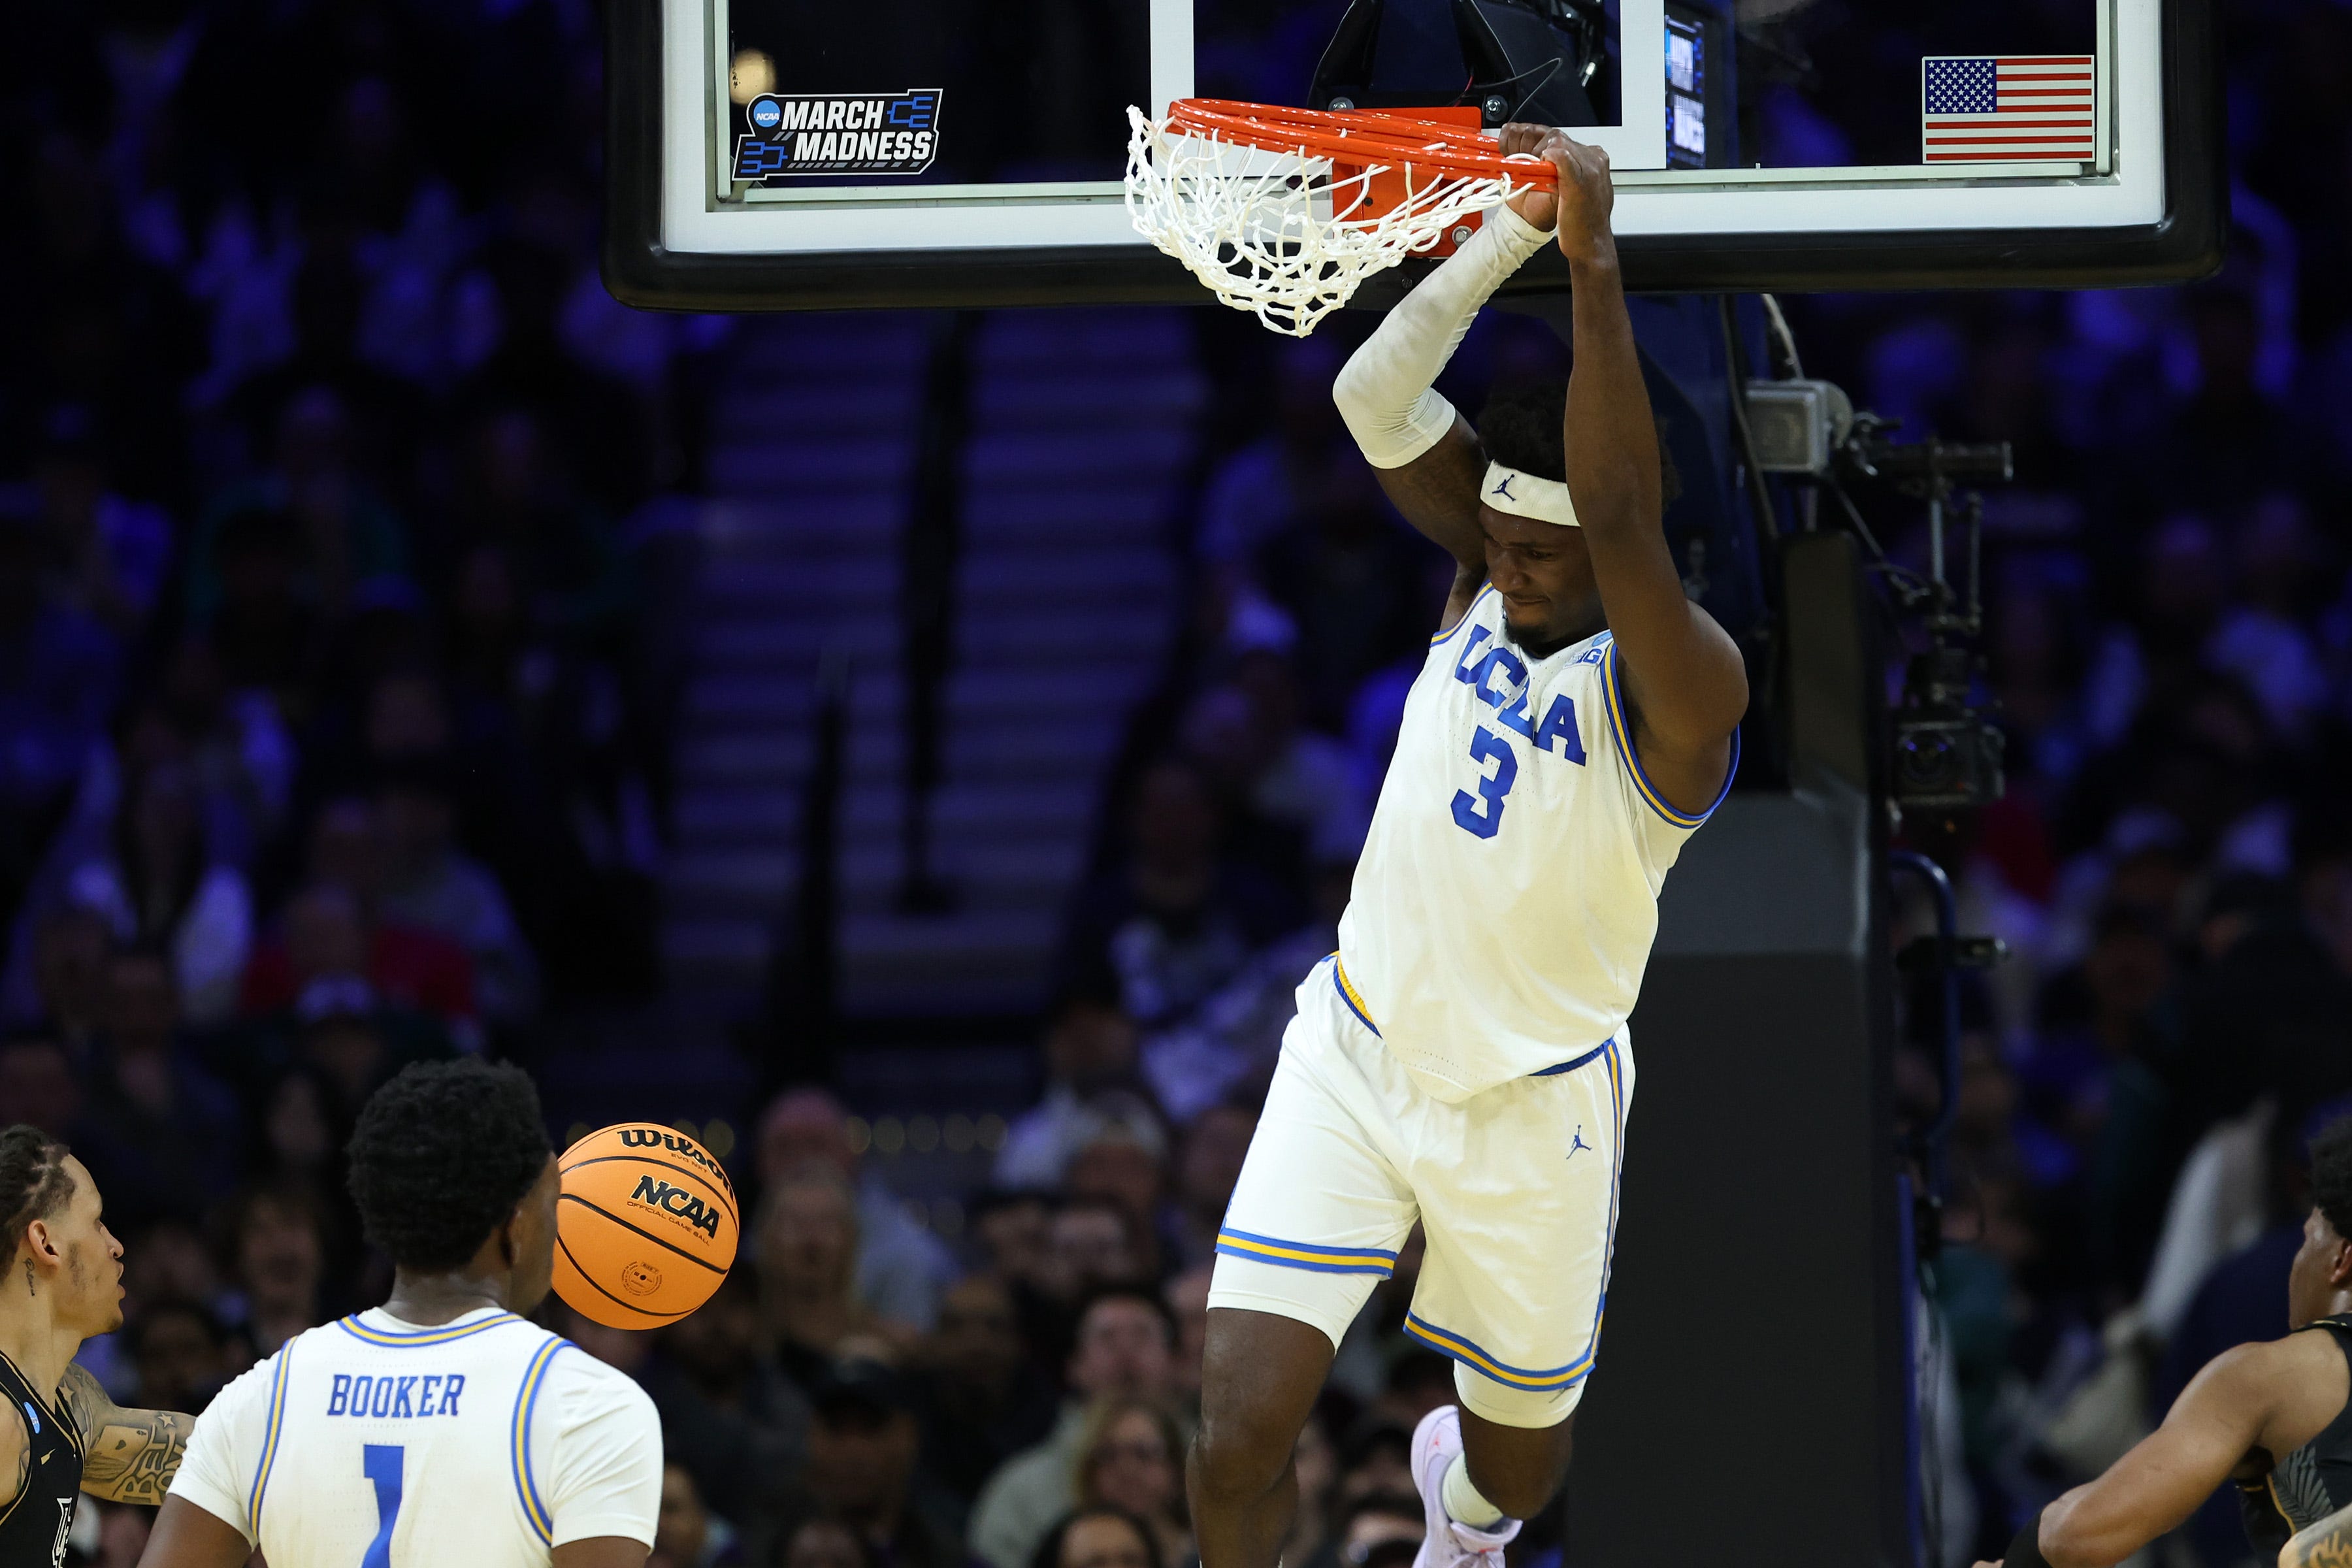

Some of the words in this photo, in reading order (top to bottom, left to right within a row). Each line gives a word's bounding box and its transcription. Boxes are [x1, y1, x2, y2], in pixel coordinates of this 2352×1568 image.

[756, 112, 780, 121] NCAA
[781, 101, 885, 130] MARCH
[793, 131, 932, 161] MADNESS
[1454, 624, 1587, 766] UCLA
[1450, 725, 1518, 840] 3
[670, 1152, 689, 1163] EVO
[691, 1160, 708, 1173] NXT
[627, 1201, 666, 1219] OFFICIAL
[668, 1217, 693, 1233] GAME
[693, 1230, 710, 1247] BALL
[630, 1174, 720, 1239] NCAA
[327, 1374, 465, 1418] BOOKER
[361, 1444, 404, 1568] 1
